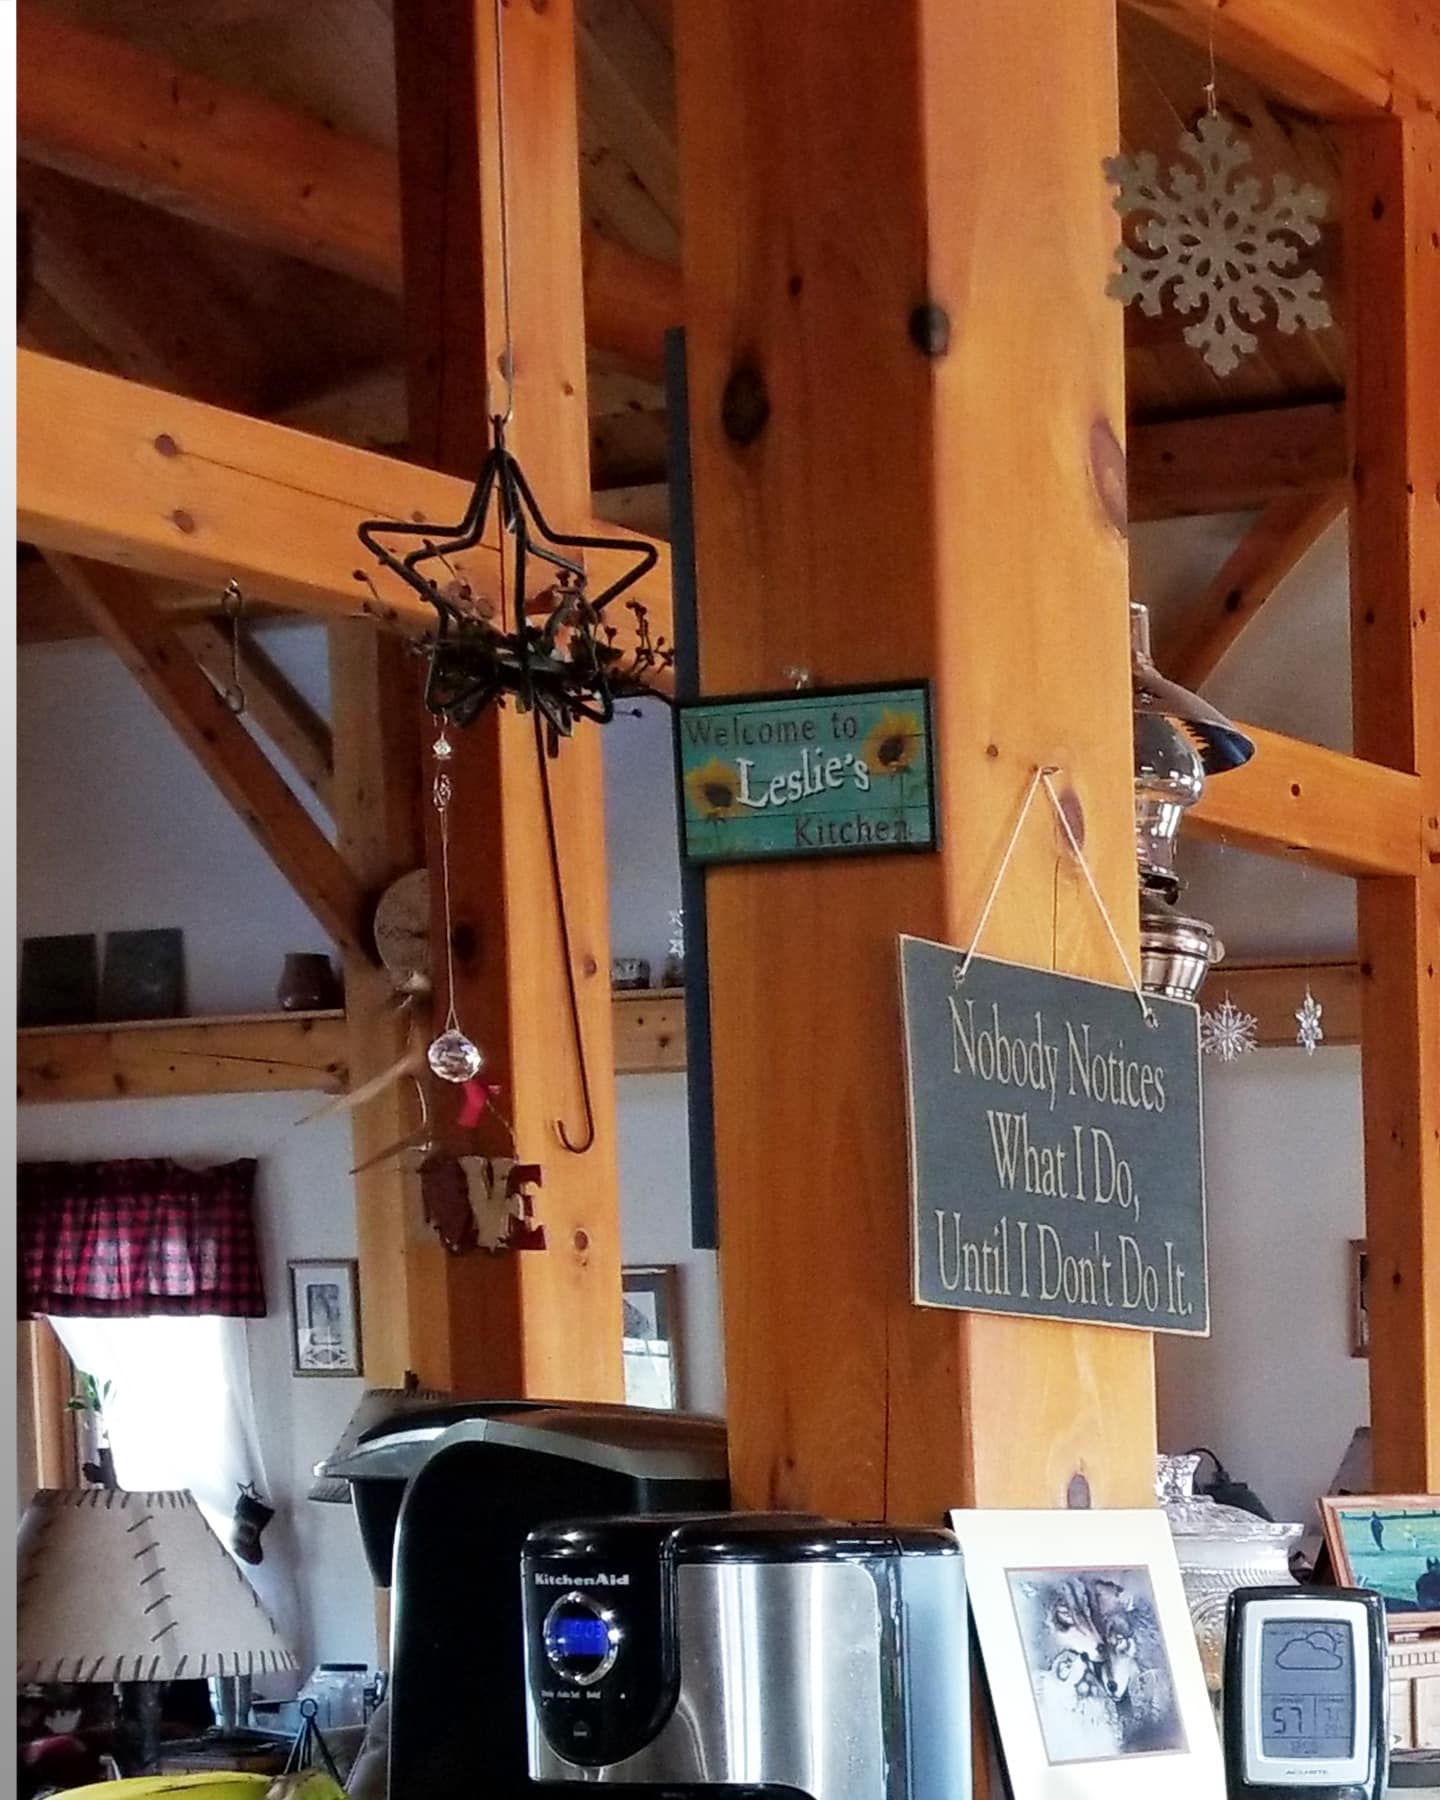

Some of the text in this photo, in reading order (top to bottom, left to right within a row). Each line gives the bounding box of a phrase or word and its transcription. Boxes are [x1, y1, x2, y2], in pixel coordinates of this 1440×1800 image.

[684, 711, 857, 746] Welcome to
[736, 747, 871, 808] Leslie's
[794, 815, 909, 847] Kitchen
[948, 996, 1166, 1112] Nobody Notices
[986, 1110, 1140, 1222] What I Do,
[935, 1210, 1193, 1315] Until I Don't Do It.
[535, 1573, 630, 1586] KitchenAid
[1272, 1706, 1303, 1735] 57
